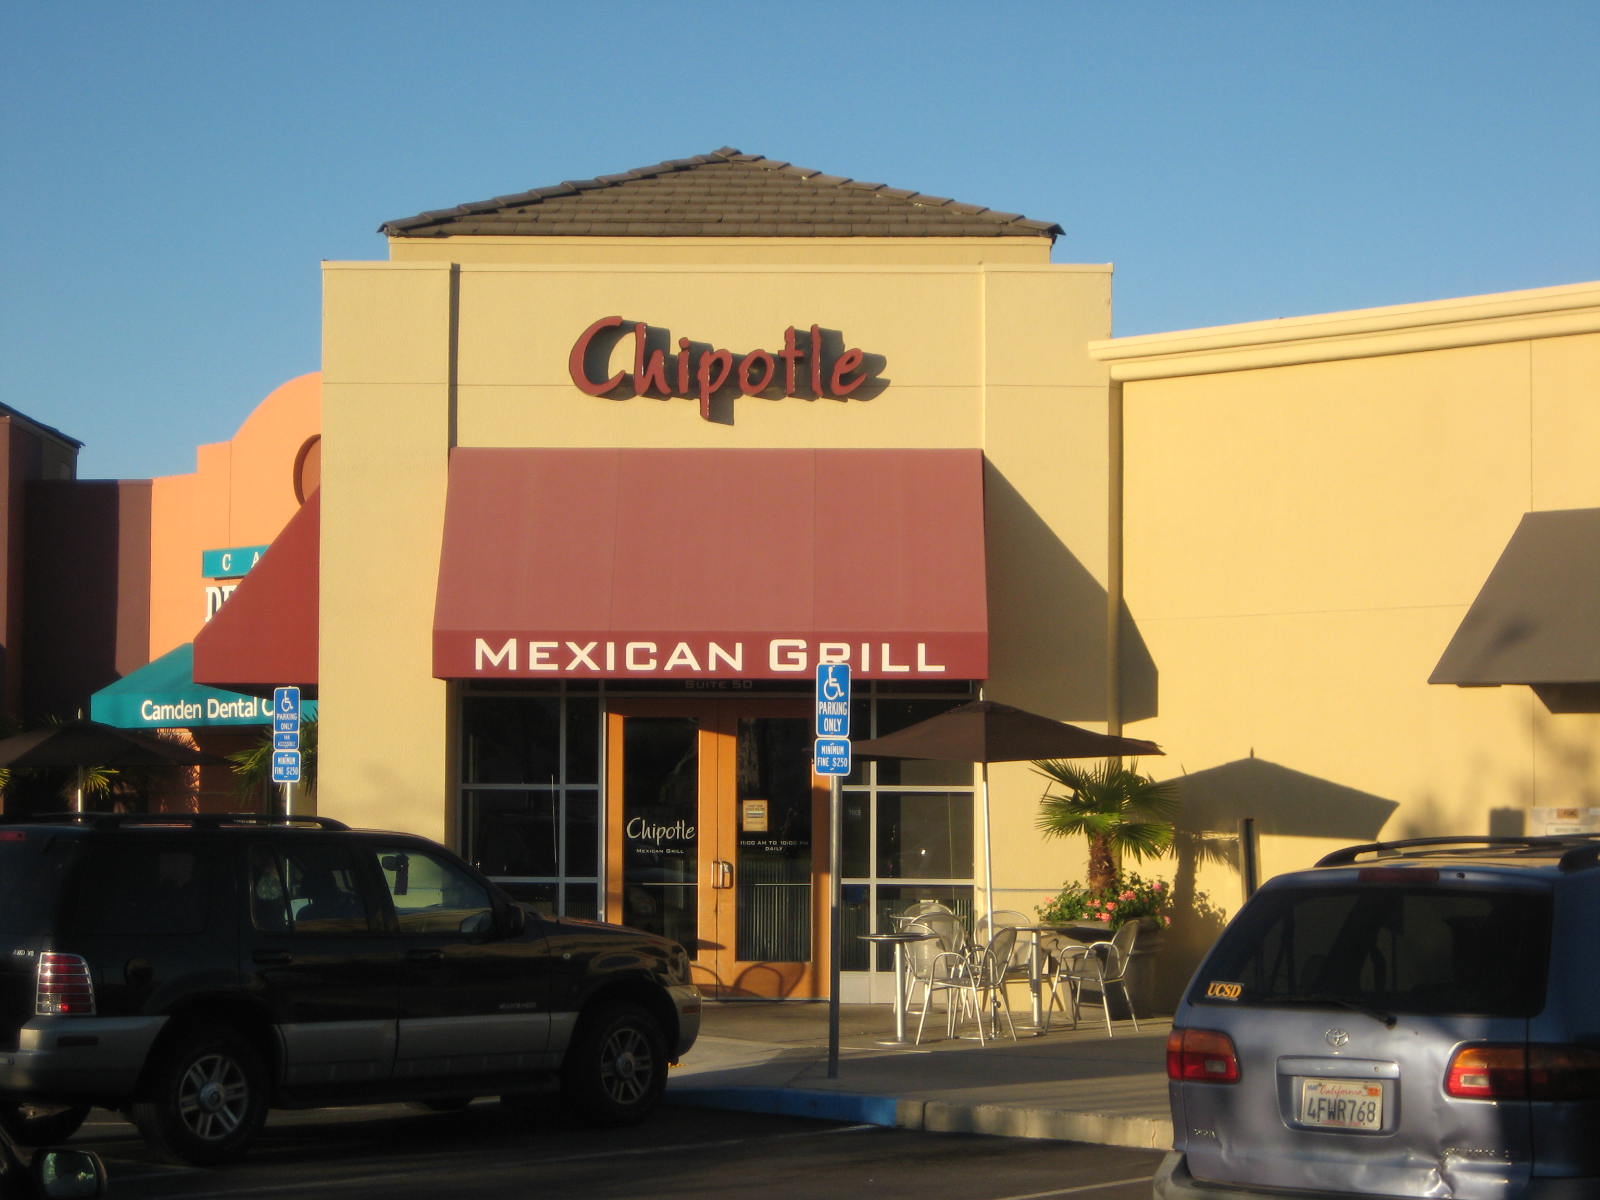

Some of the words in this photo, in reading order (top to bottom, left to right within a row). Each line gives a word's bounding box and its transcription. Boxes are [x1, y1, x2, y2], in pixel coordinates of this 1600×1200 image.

[568, 315, 869, 421] Chipotle
[475, 638, 743, 671] MEXICAN
[769, 638, 947, 672] GRILL
[141, 701, 201, 720] Camden
[207, 697, 257, 719] Dental
[818, 701, 848, 715] PARKING
[280, 722, 294, 730] ONLY
[823, 718, 842, 732] ONLY
[821, 745, 845, 755] MINIMUM
[817, 757, 830, 767] FINE
[832, 757, 848, 768] $250
[626, 817, 696, 846] Chipotle
[1207, 982, 1242, 998] UCSD
[1307, 1097, 1377, 1123] 4FWR768
